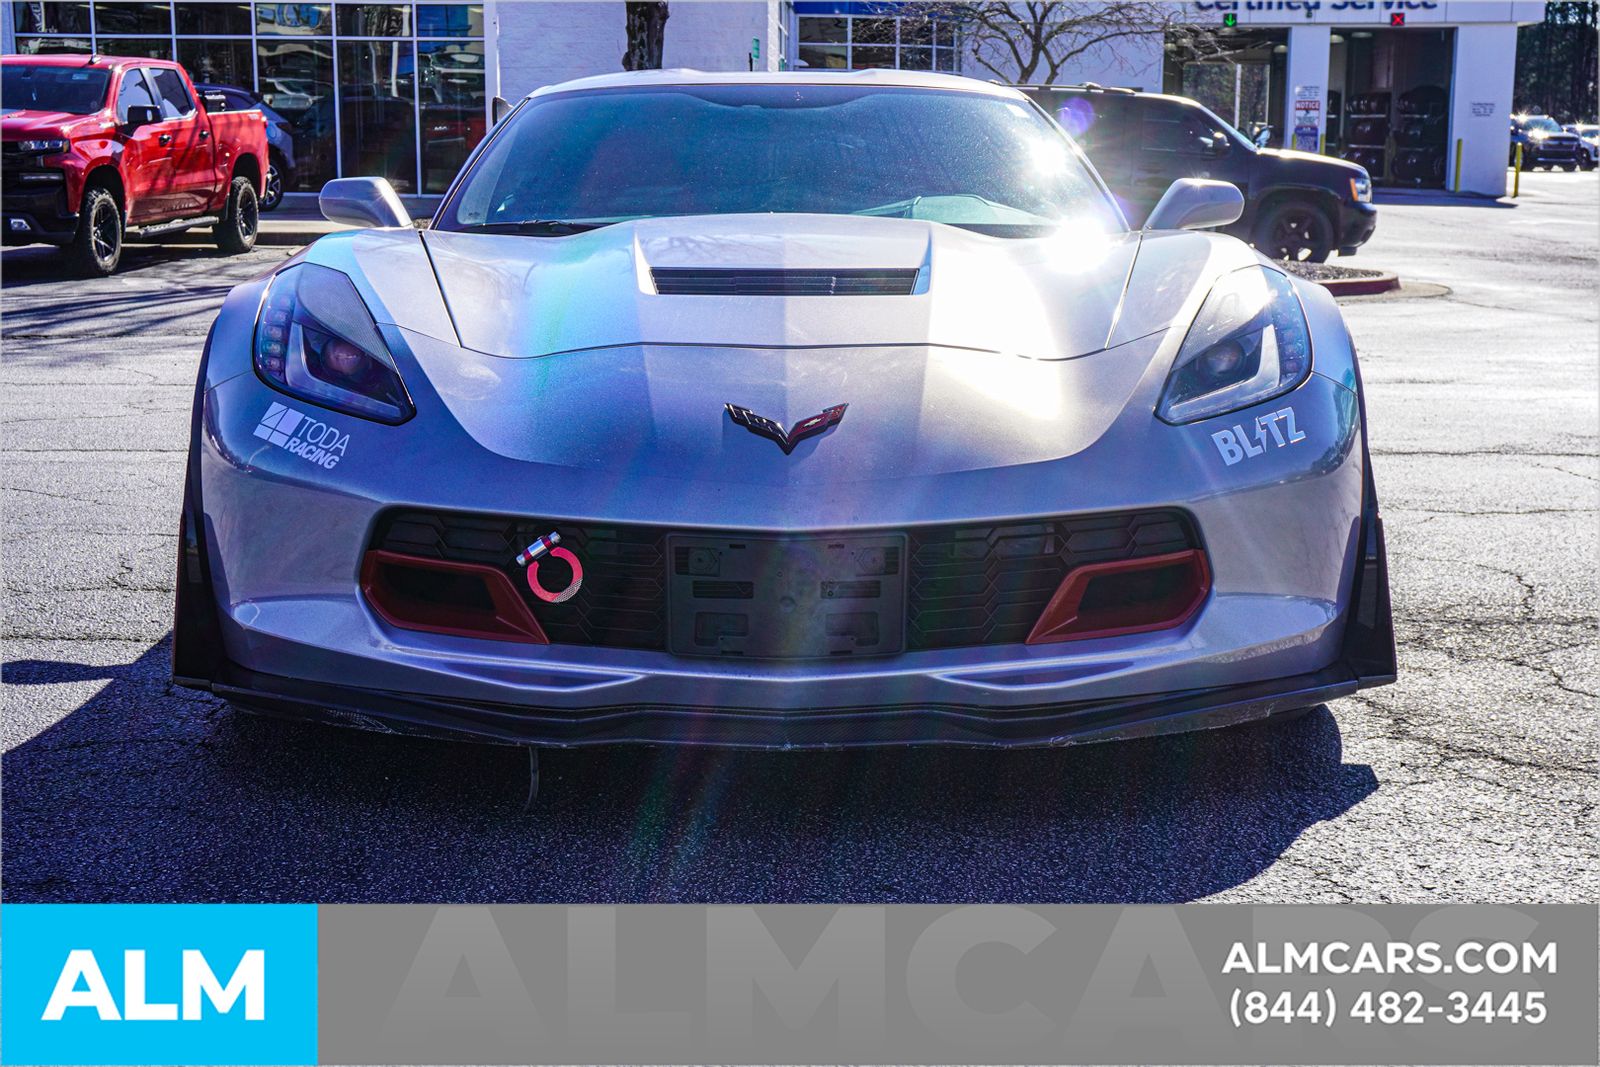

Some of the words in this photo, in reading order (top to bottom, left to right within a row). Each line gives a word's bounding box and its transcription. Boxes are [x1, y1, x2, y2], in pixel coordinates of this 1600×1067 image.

[283, 437, 340, 469] RACING
[298, 416, 350, 457] TODA
[1211, 406, 1306, 466] BLITZ
